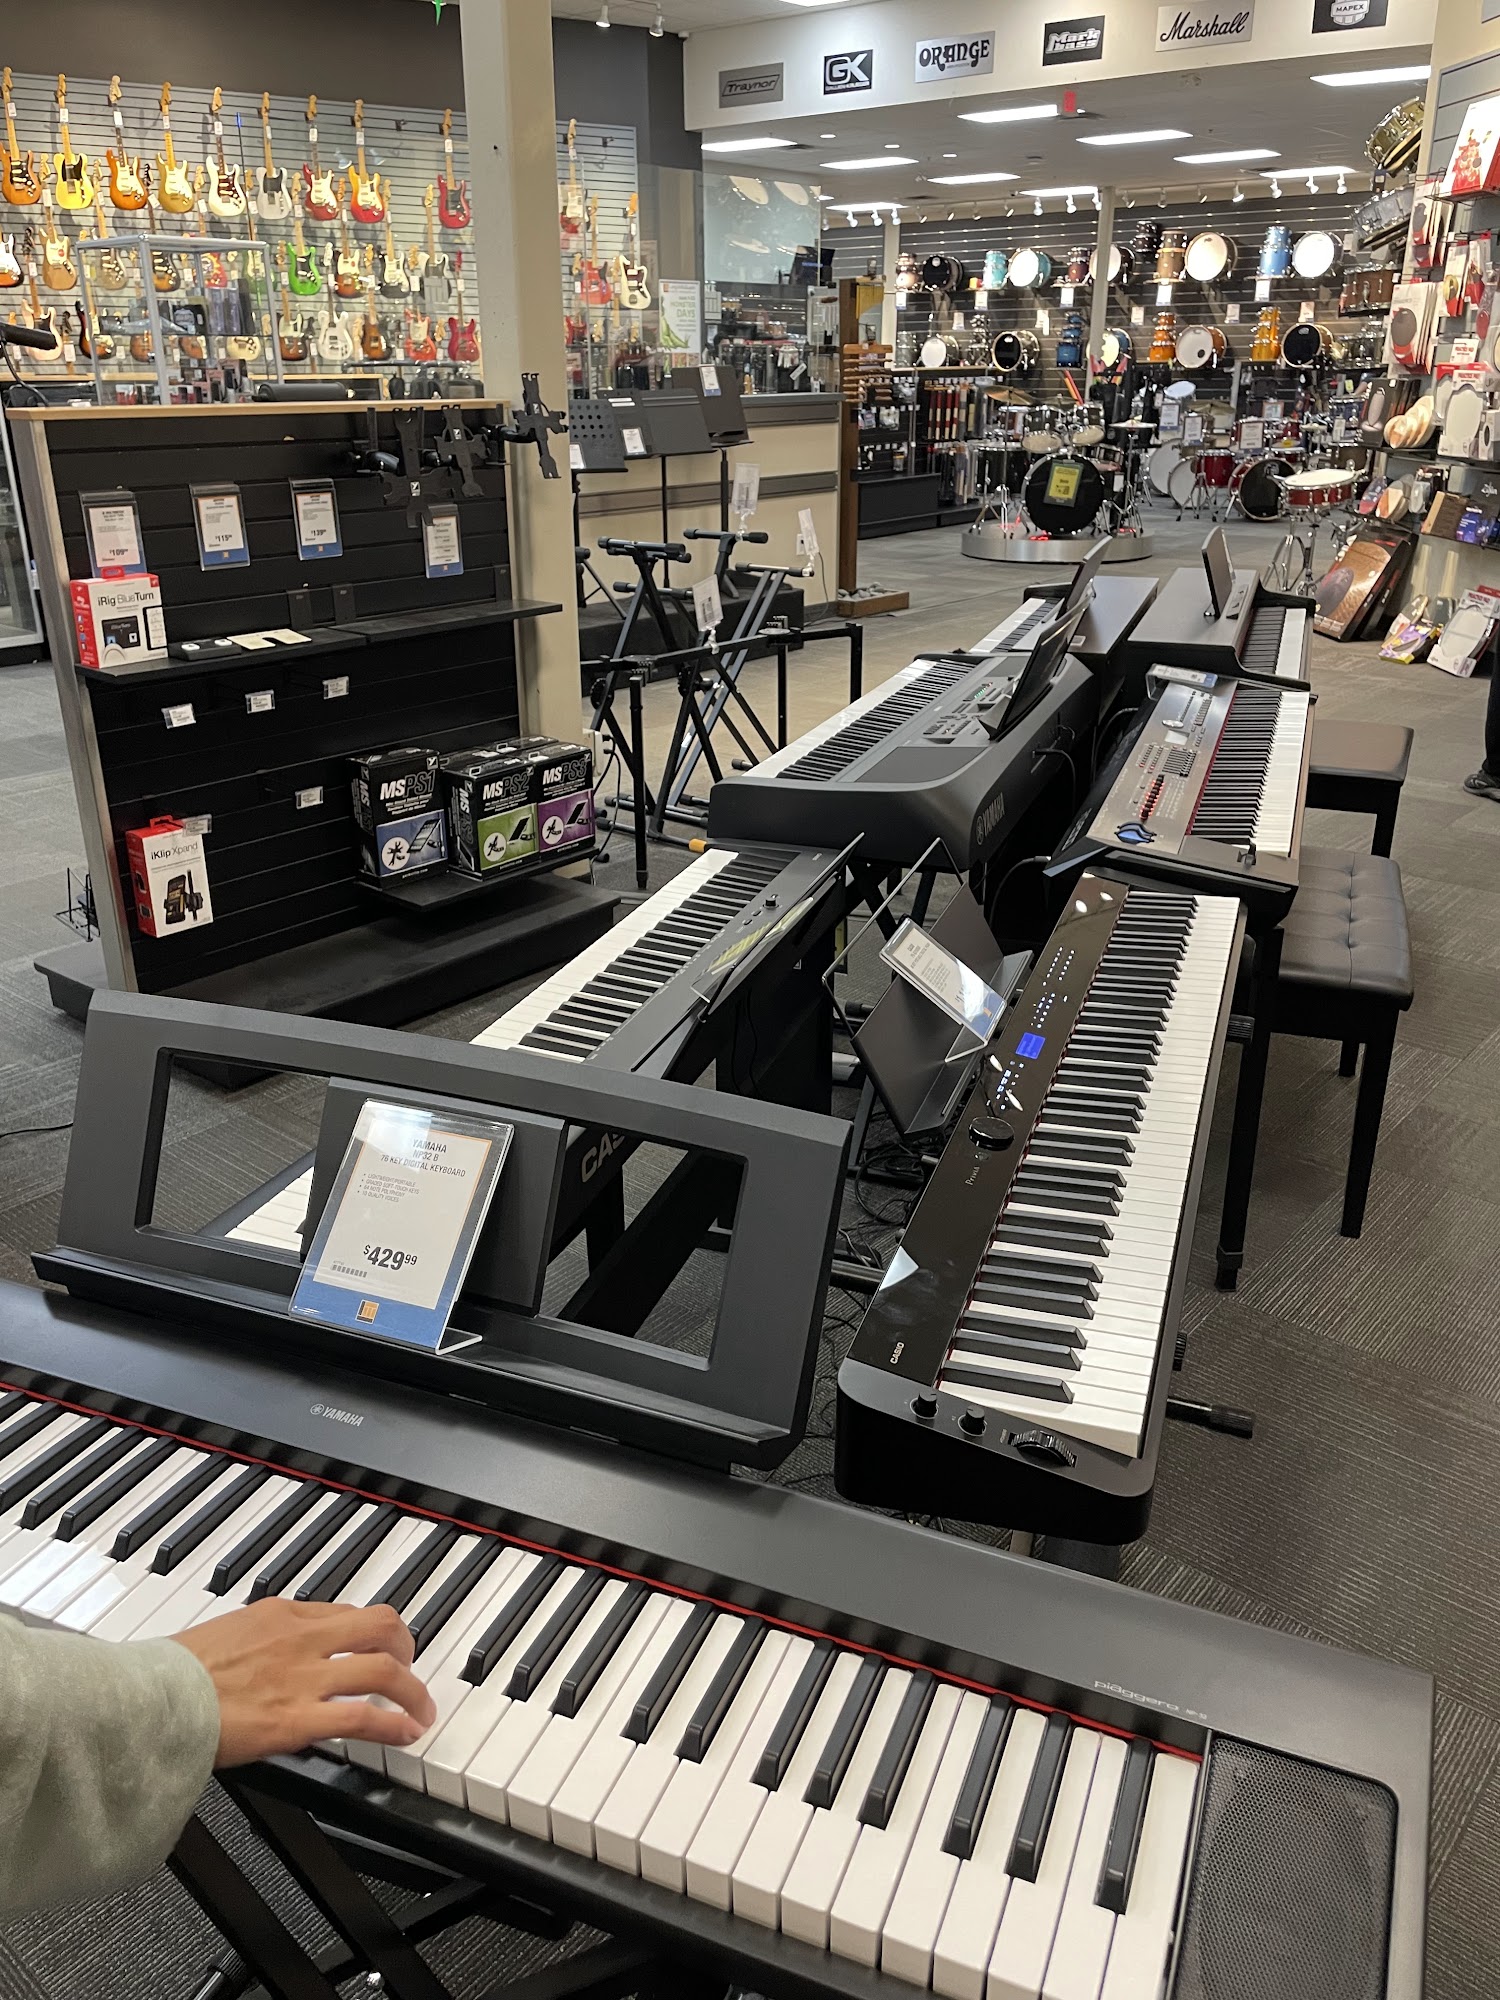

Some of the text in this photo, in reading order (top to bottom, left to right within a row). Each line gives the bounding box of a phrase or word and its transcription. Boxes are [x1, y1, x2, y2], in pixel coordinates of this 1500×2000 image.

[1336, 3, 1364, 13] MAPEX
[1160, 11, 1250, 42] Marshall
[919, 39, 991, 72] ORANGE
[826, 53, 870, 86] GK
[727, 75, 776, 93] Traynor
[98, 595, 116, 607] iRig
[380, 769, 436, 800] MSPS1
[151, 849, 171, 860] iKlip
[412, 1139, 447, 1153] YAMAHA
[413, 1149, 432, 1161] NP32
[380, 1154, 466, 1177] 76 KEY DIGITAL KEYBOARD
[889, 1341, 905, 1364] CASIO
[322, 1406, 365, 1427] YAMAHA
[1094, 1680, 1180, 1711] piaggero
